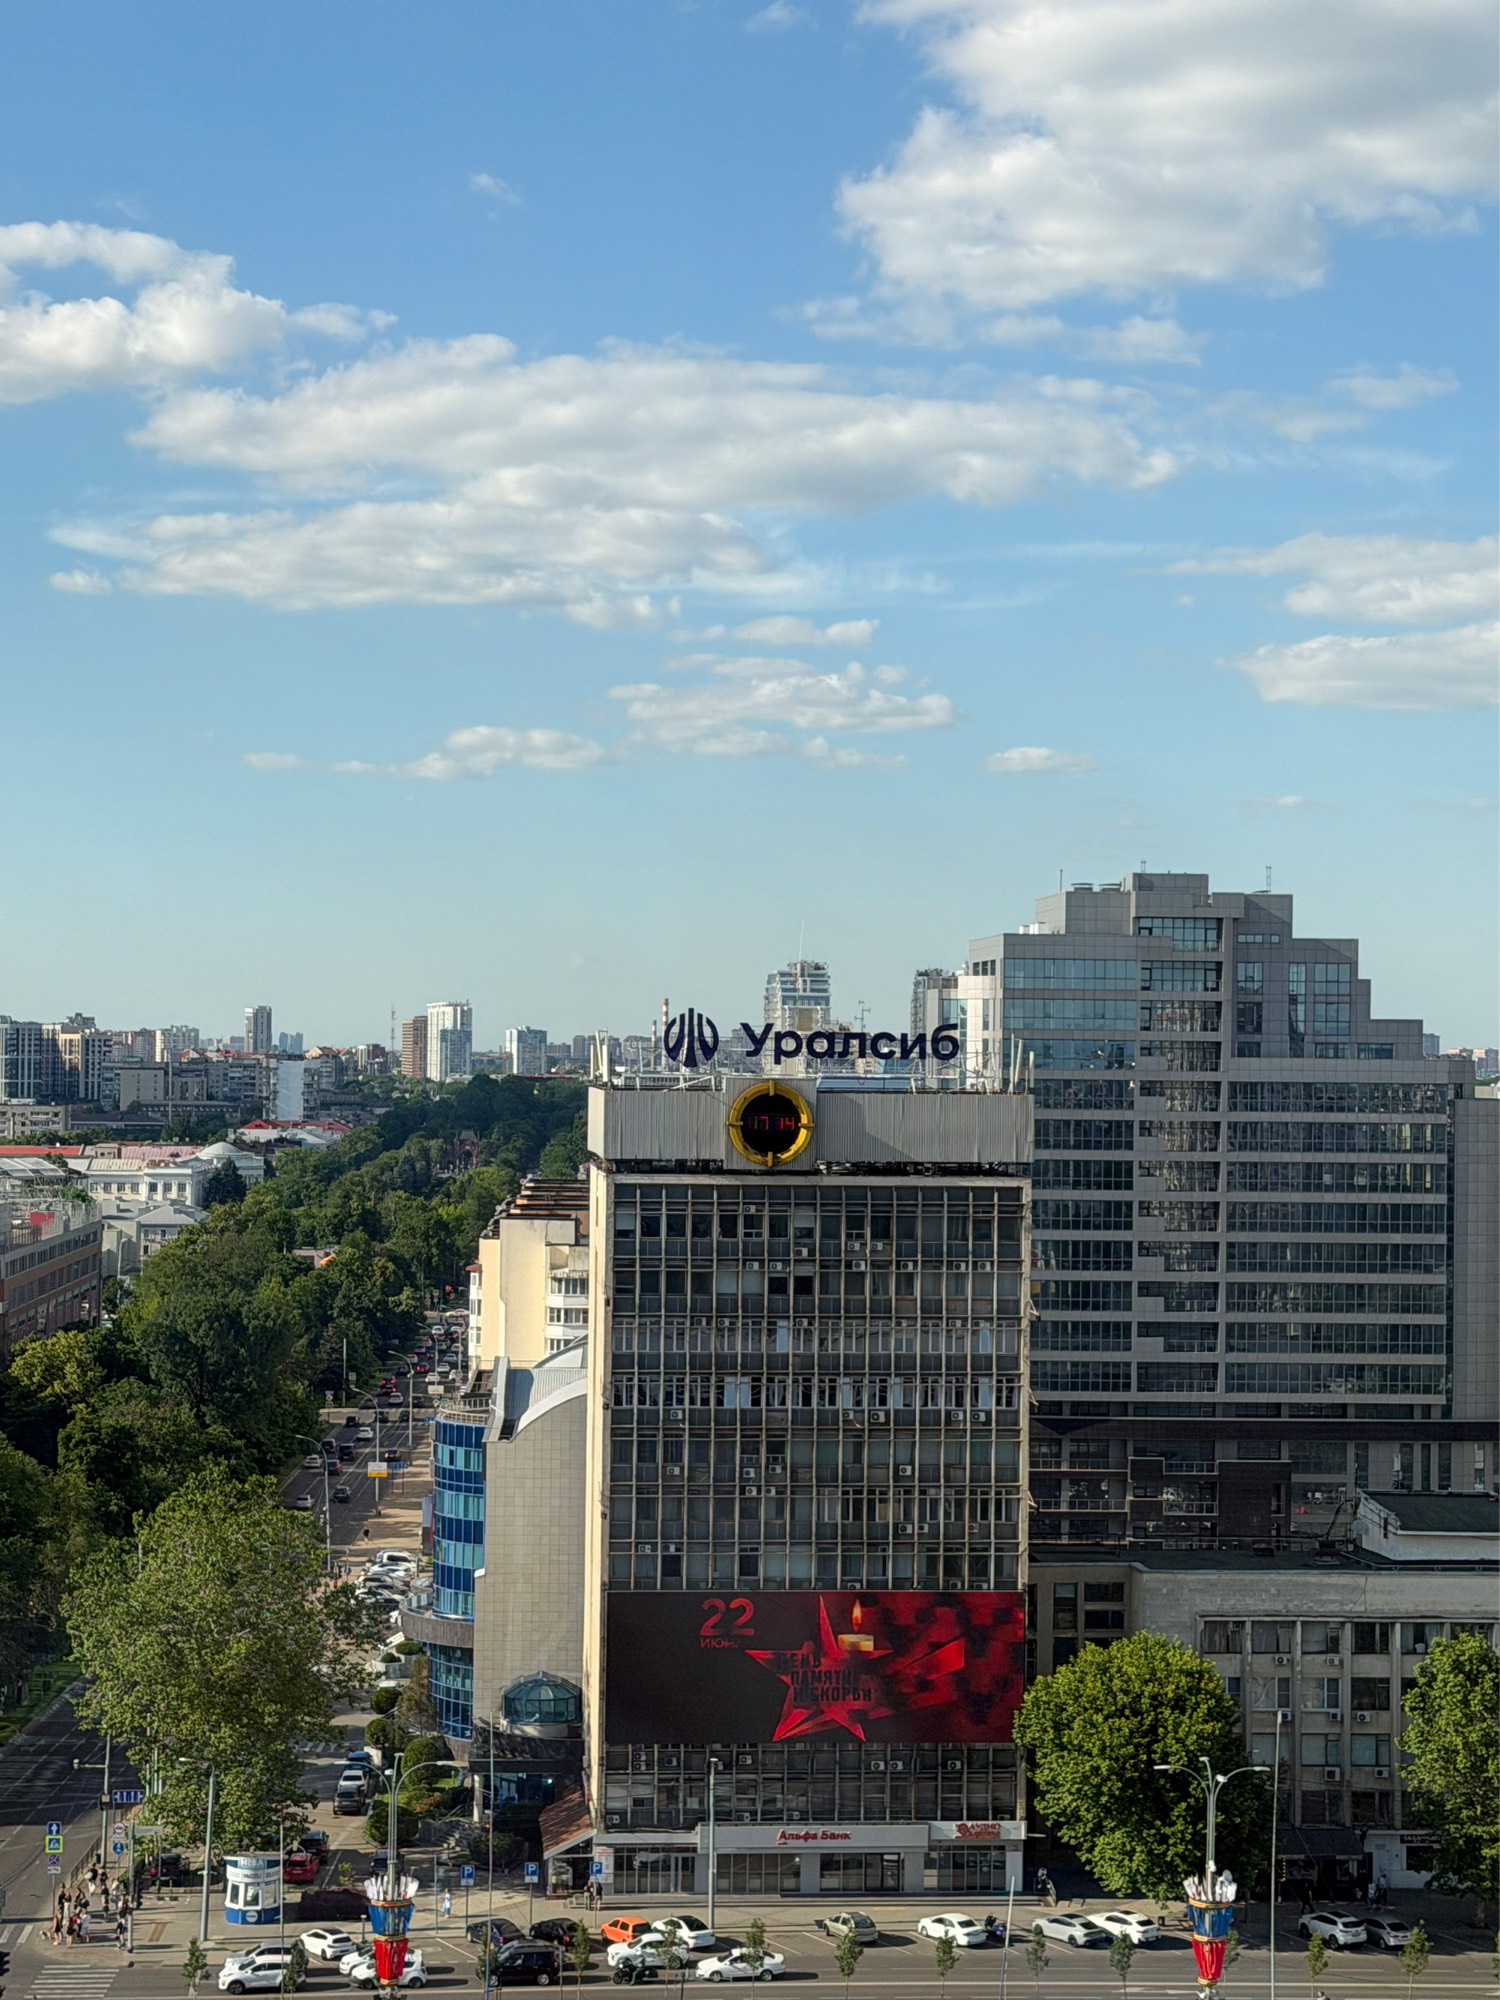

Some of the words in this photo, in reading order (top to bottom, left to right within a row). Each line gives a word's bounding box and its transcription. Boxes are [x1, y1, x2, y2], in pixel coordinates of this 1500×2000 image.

[740, 1022, 960, 1065] Уралсиб
[700, 1598, 755, 1636] 22
[791, 1669, 852, 1686] ПАМЯТИ
[809, 1686, 872, 1702] СКОРБИ
[776, 1828, 818, 1845] Альфа
[820, 1829, 852, 1840] Банк
